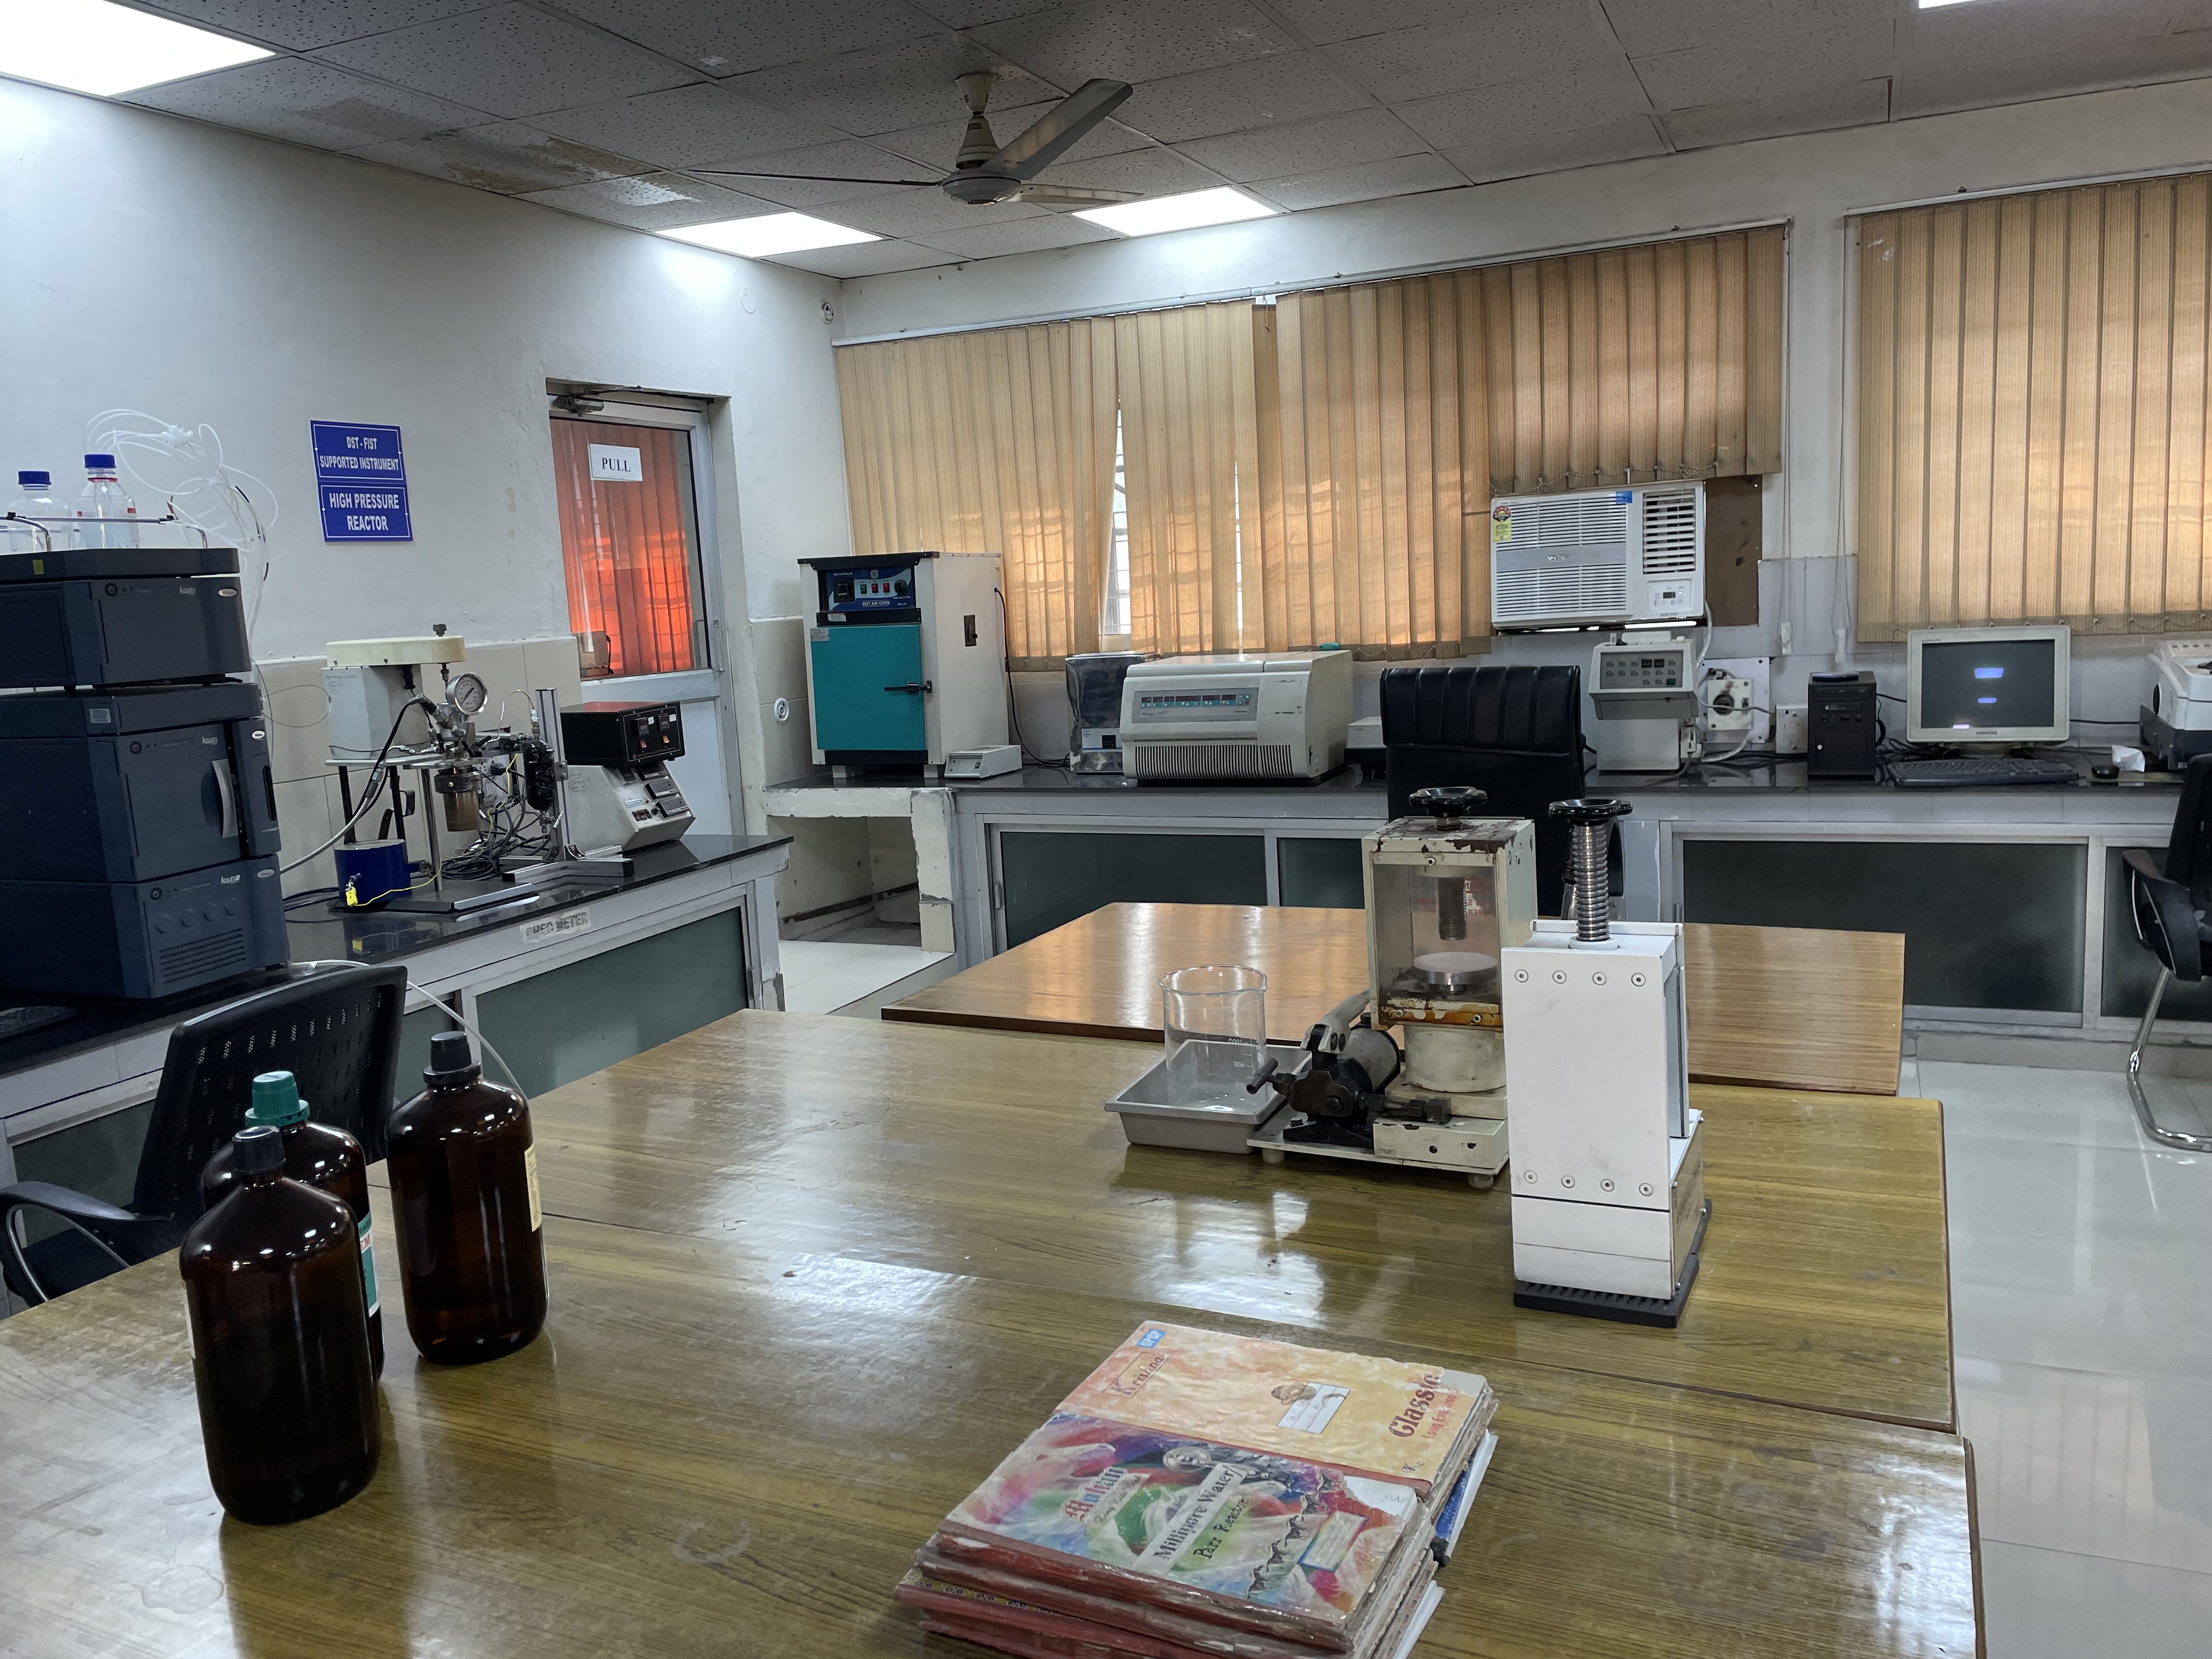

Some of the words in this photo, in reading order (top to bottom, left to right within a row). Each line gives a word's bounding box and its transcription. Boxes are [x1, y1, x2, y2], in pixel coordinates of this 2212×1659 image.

[346, 436, 359, 449] DST
[363, 437, 377, 450] FIST
[320, 455, 358, 469] SUPPORTED
[359, 457, 399, 471] INSTRUMENT
[601, 458, 631, 472] PULL
[329, 493, 353, 509] HIGH
[354, 494, 400, 509] PRESSURE
[347, 515, 388, 531] REACTOR
[1153, 1505, 1207, 1560] Millipore
[1193, 1537, 1223, 1560] Parr
[1213, 1498, 1249, 1533] Reactor
